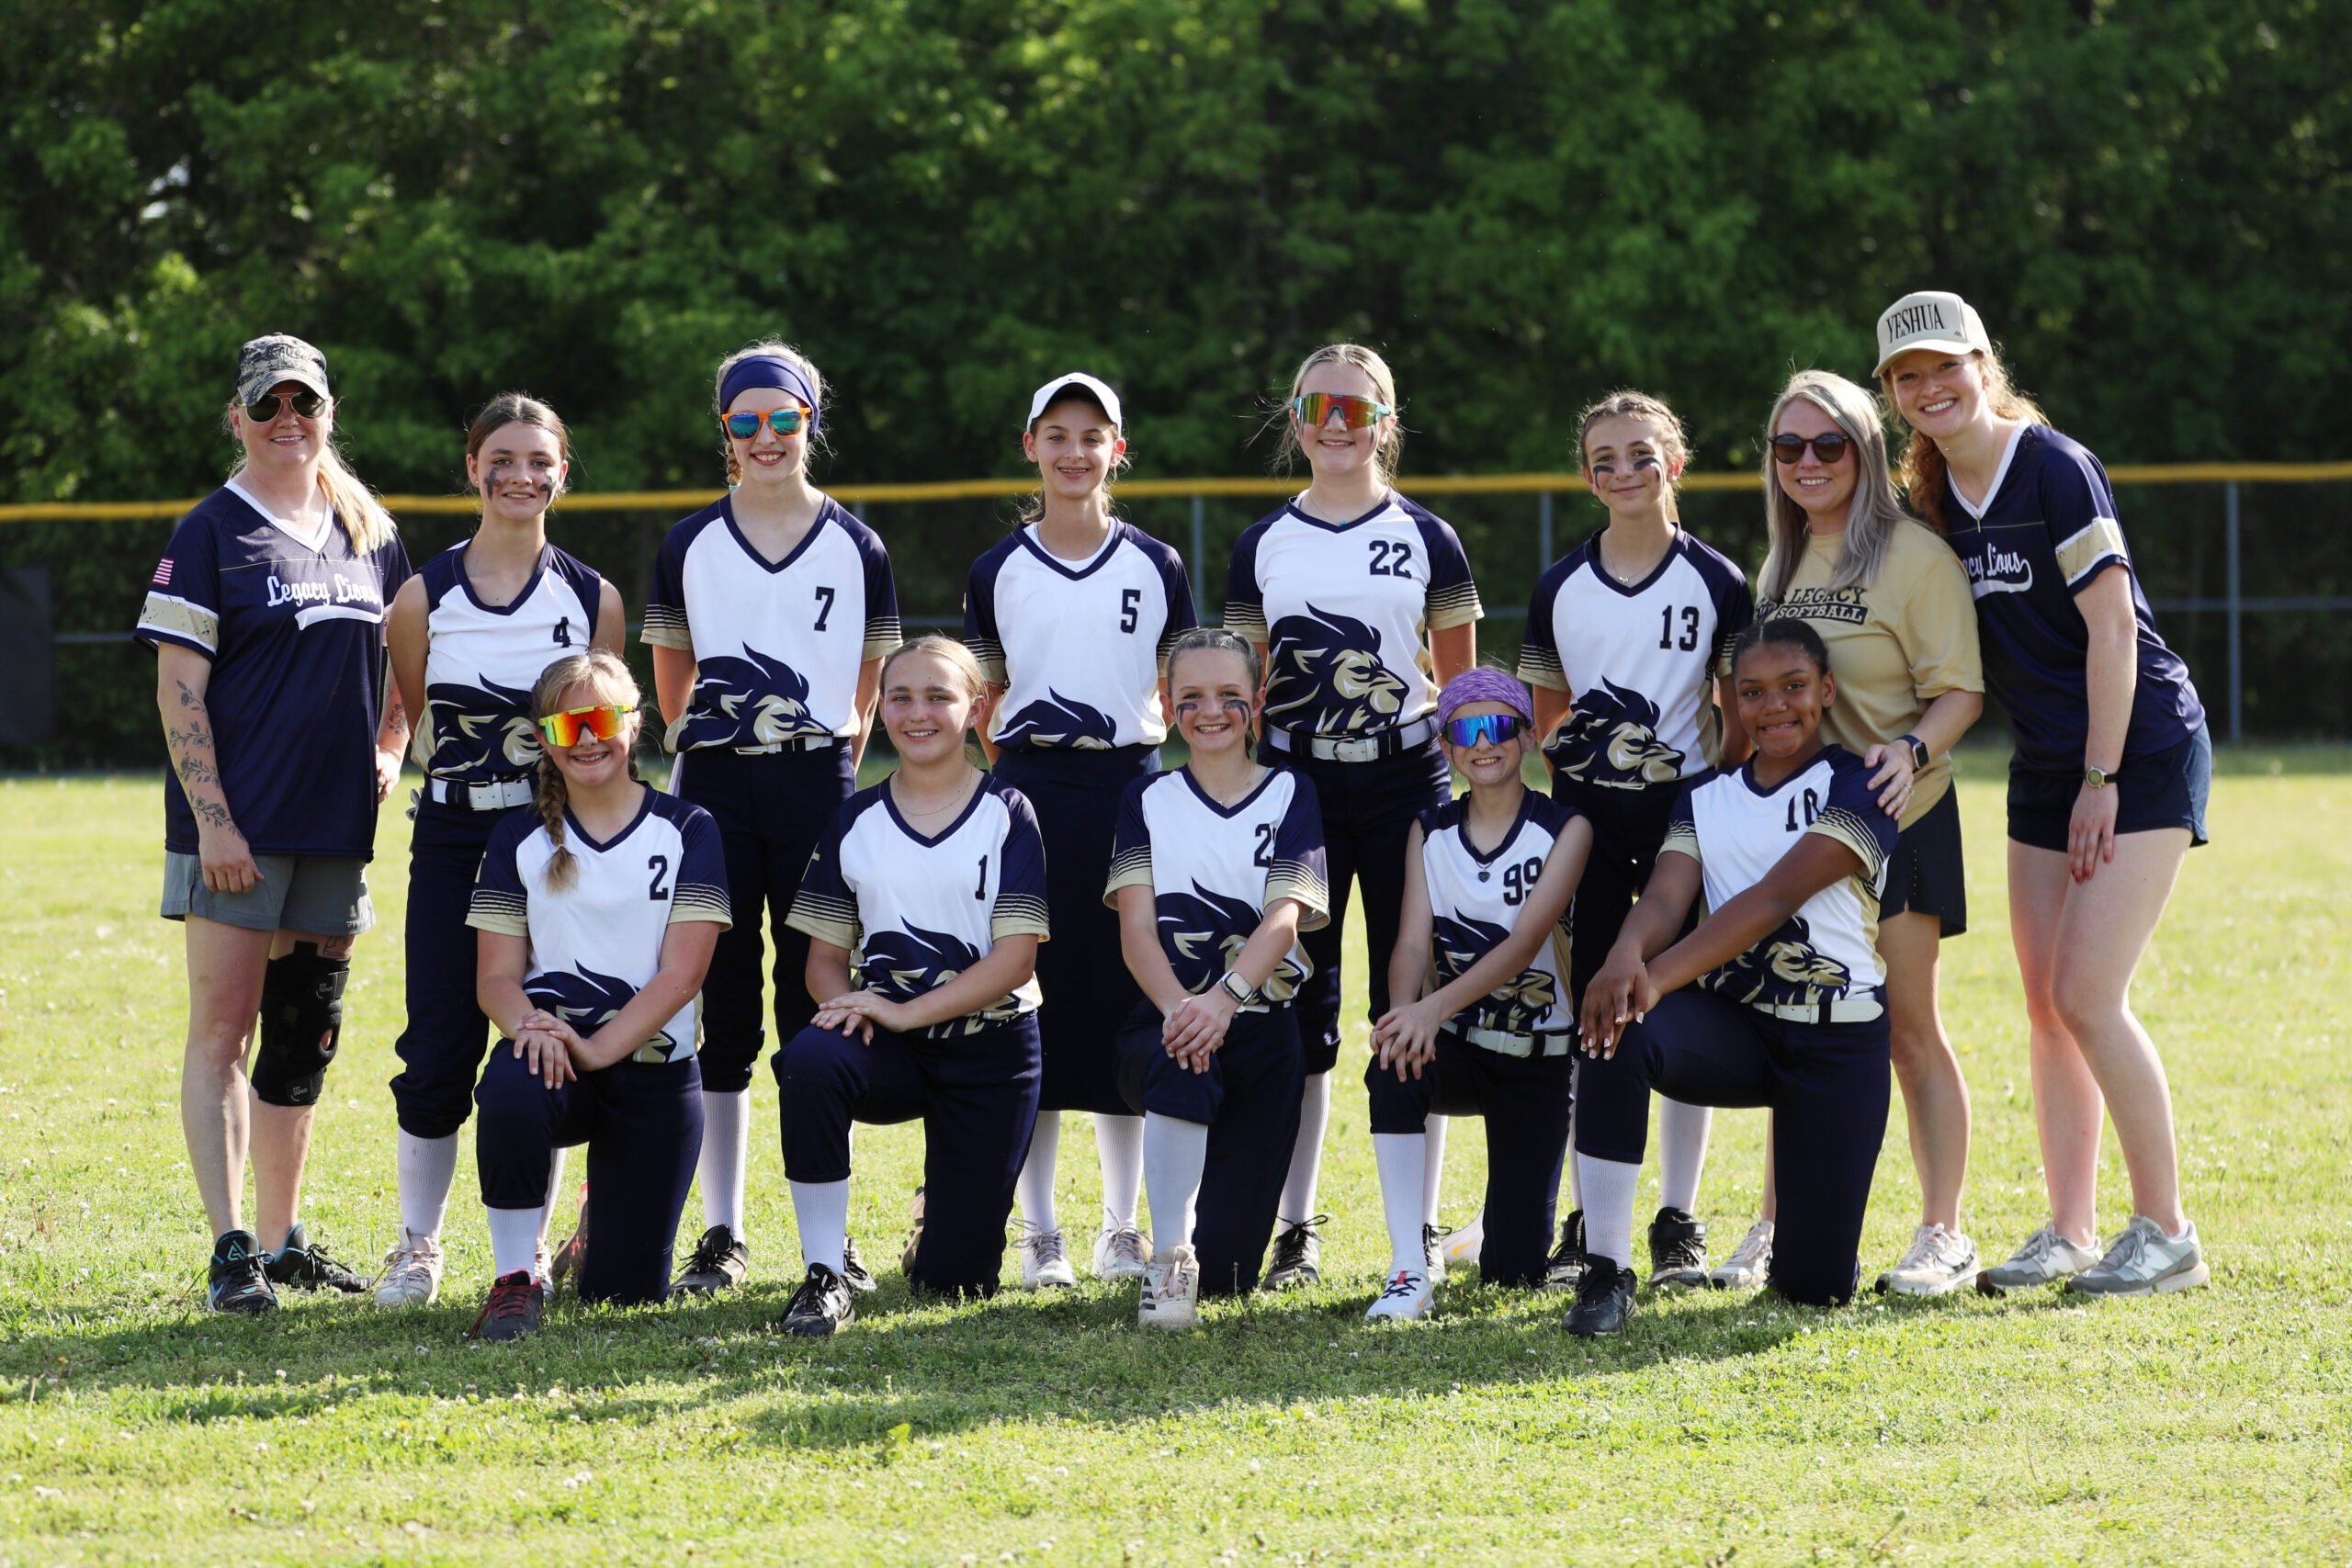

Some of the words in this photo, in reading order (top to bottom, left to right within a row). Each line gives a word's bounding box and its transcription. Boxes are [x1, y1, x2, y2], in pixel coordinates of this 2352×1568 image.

[1886, 303, 1945, 344] YESHUA
[1368, 539, 1410, 579] 22
[1986, 542, 2022, 577] Lions
[266, 575, 331, 607] Legacy
[814, 585, 835, 632] 7
[1120, 588, 1141, 634] 5
[1776, 604, 1863, 623] SOFTBALL
[1788, 587, 1868, 605] LEGACY
[552, 616, 571, 649] 4
[1659, 605, 1700, 652] 13
[1785, 786, 1818, 833] 10
[1254, 823, 1276, 868] 2
[649, 854, 669, 900] 2
[975, 854, 988, 901] 1
[1503, 856, 1543, 907] 99
